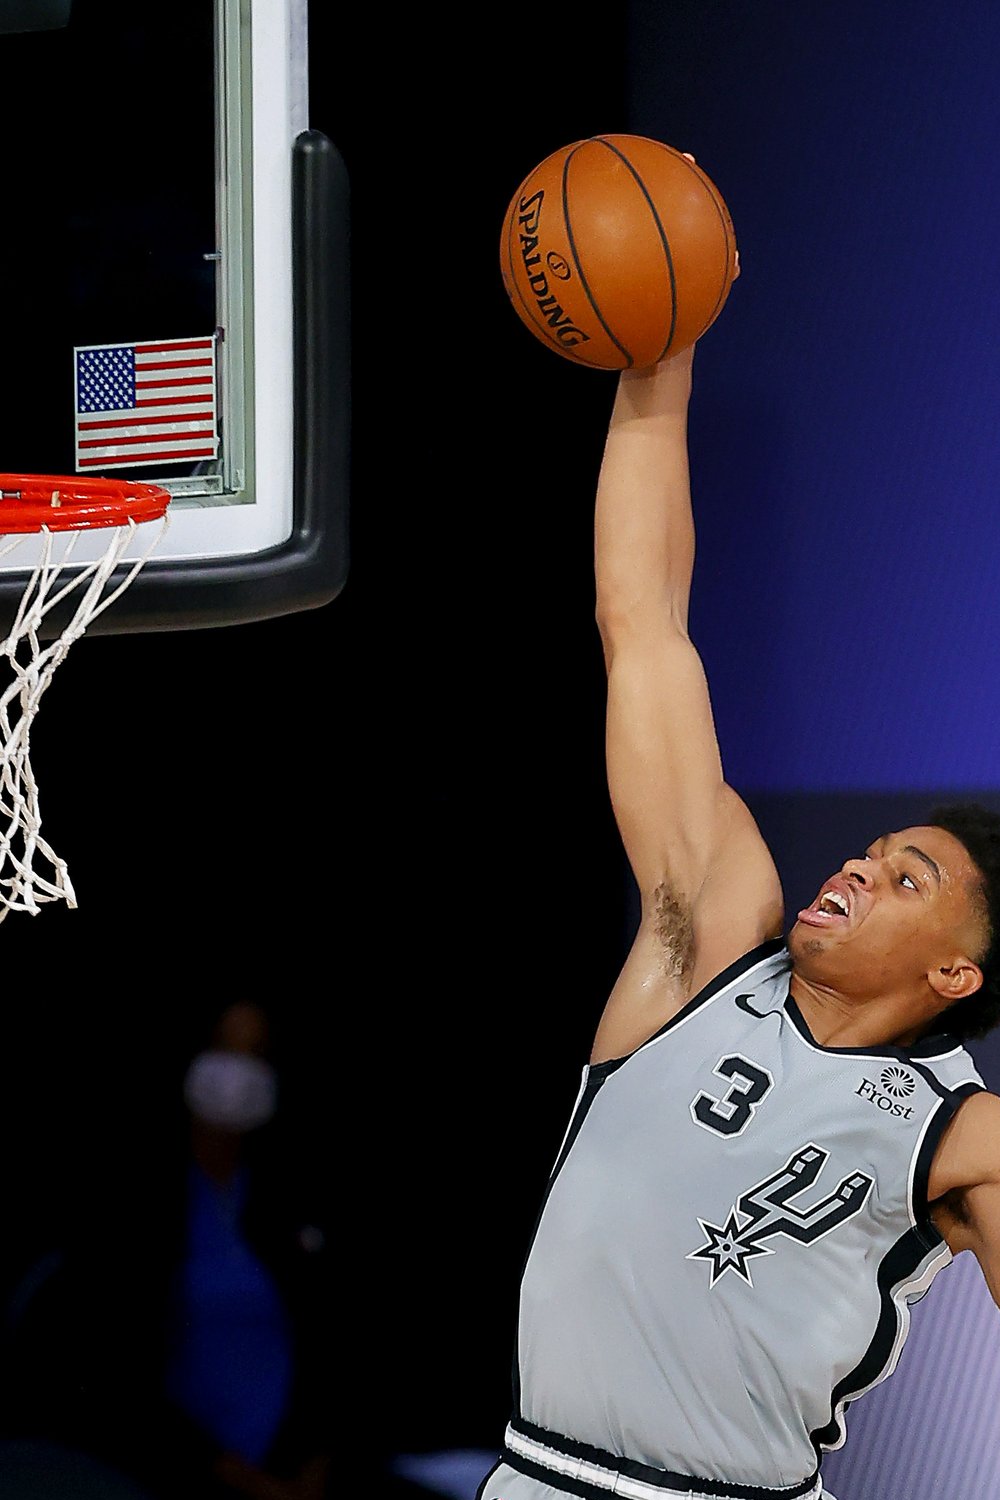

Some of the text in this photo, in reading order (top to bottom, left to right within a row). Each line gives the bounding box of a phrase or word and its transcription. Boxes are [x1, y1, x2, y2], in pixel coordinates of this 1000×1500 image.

[519, 189, 590, 348] SPALDING
[688, 1052, 776, 1140] 3
[854, 1077, 915, 1120] Frost
